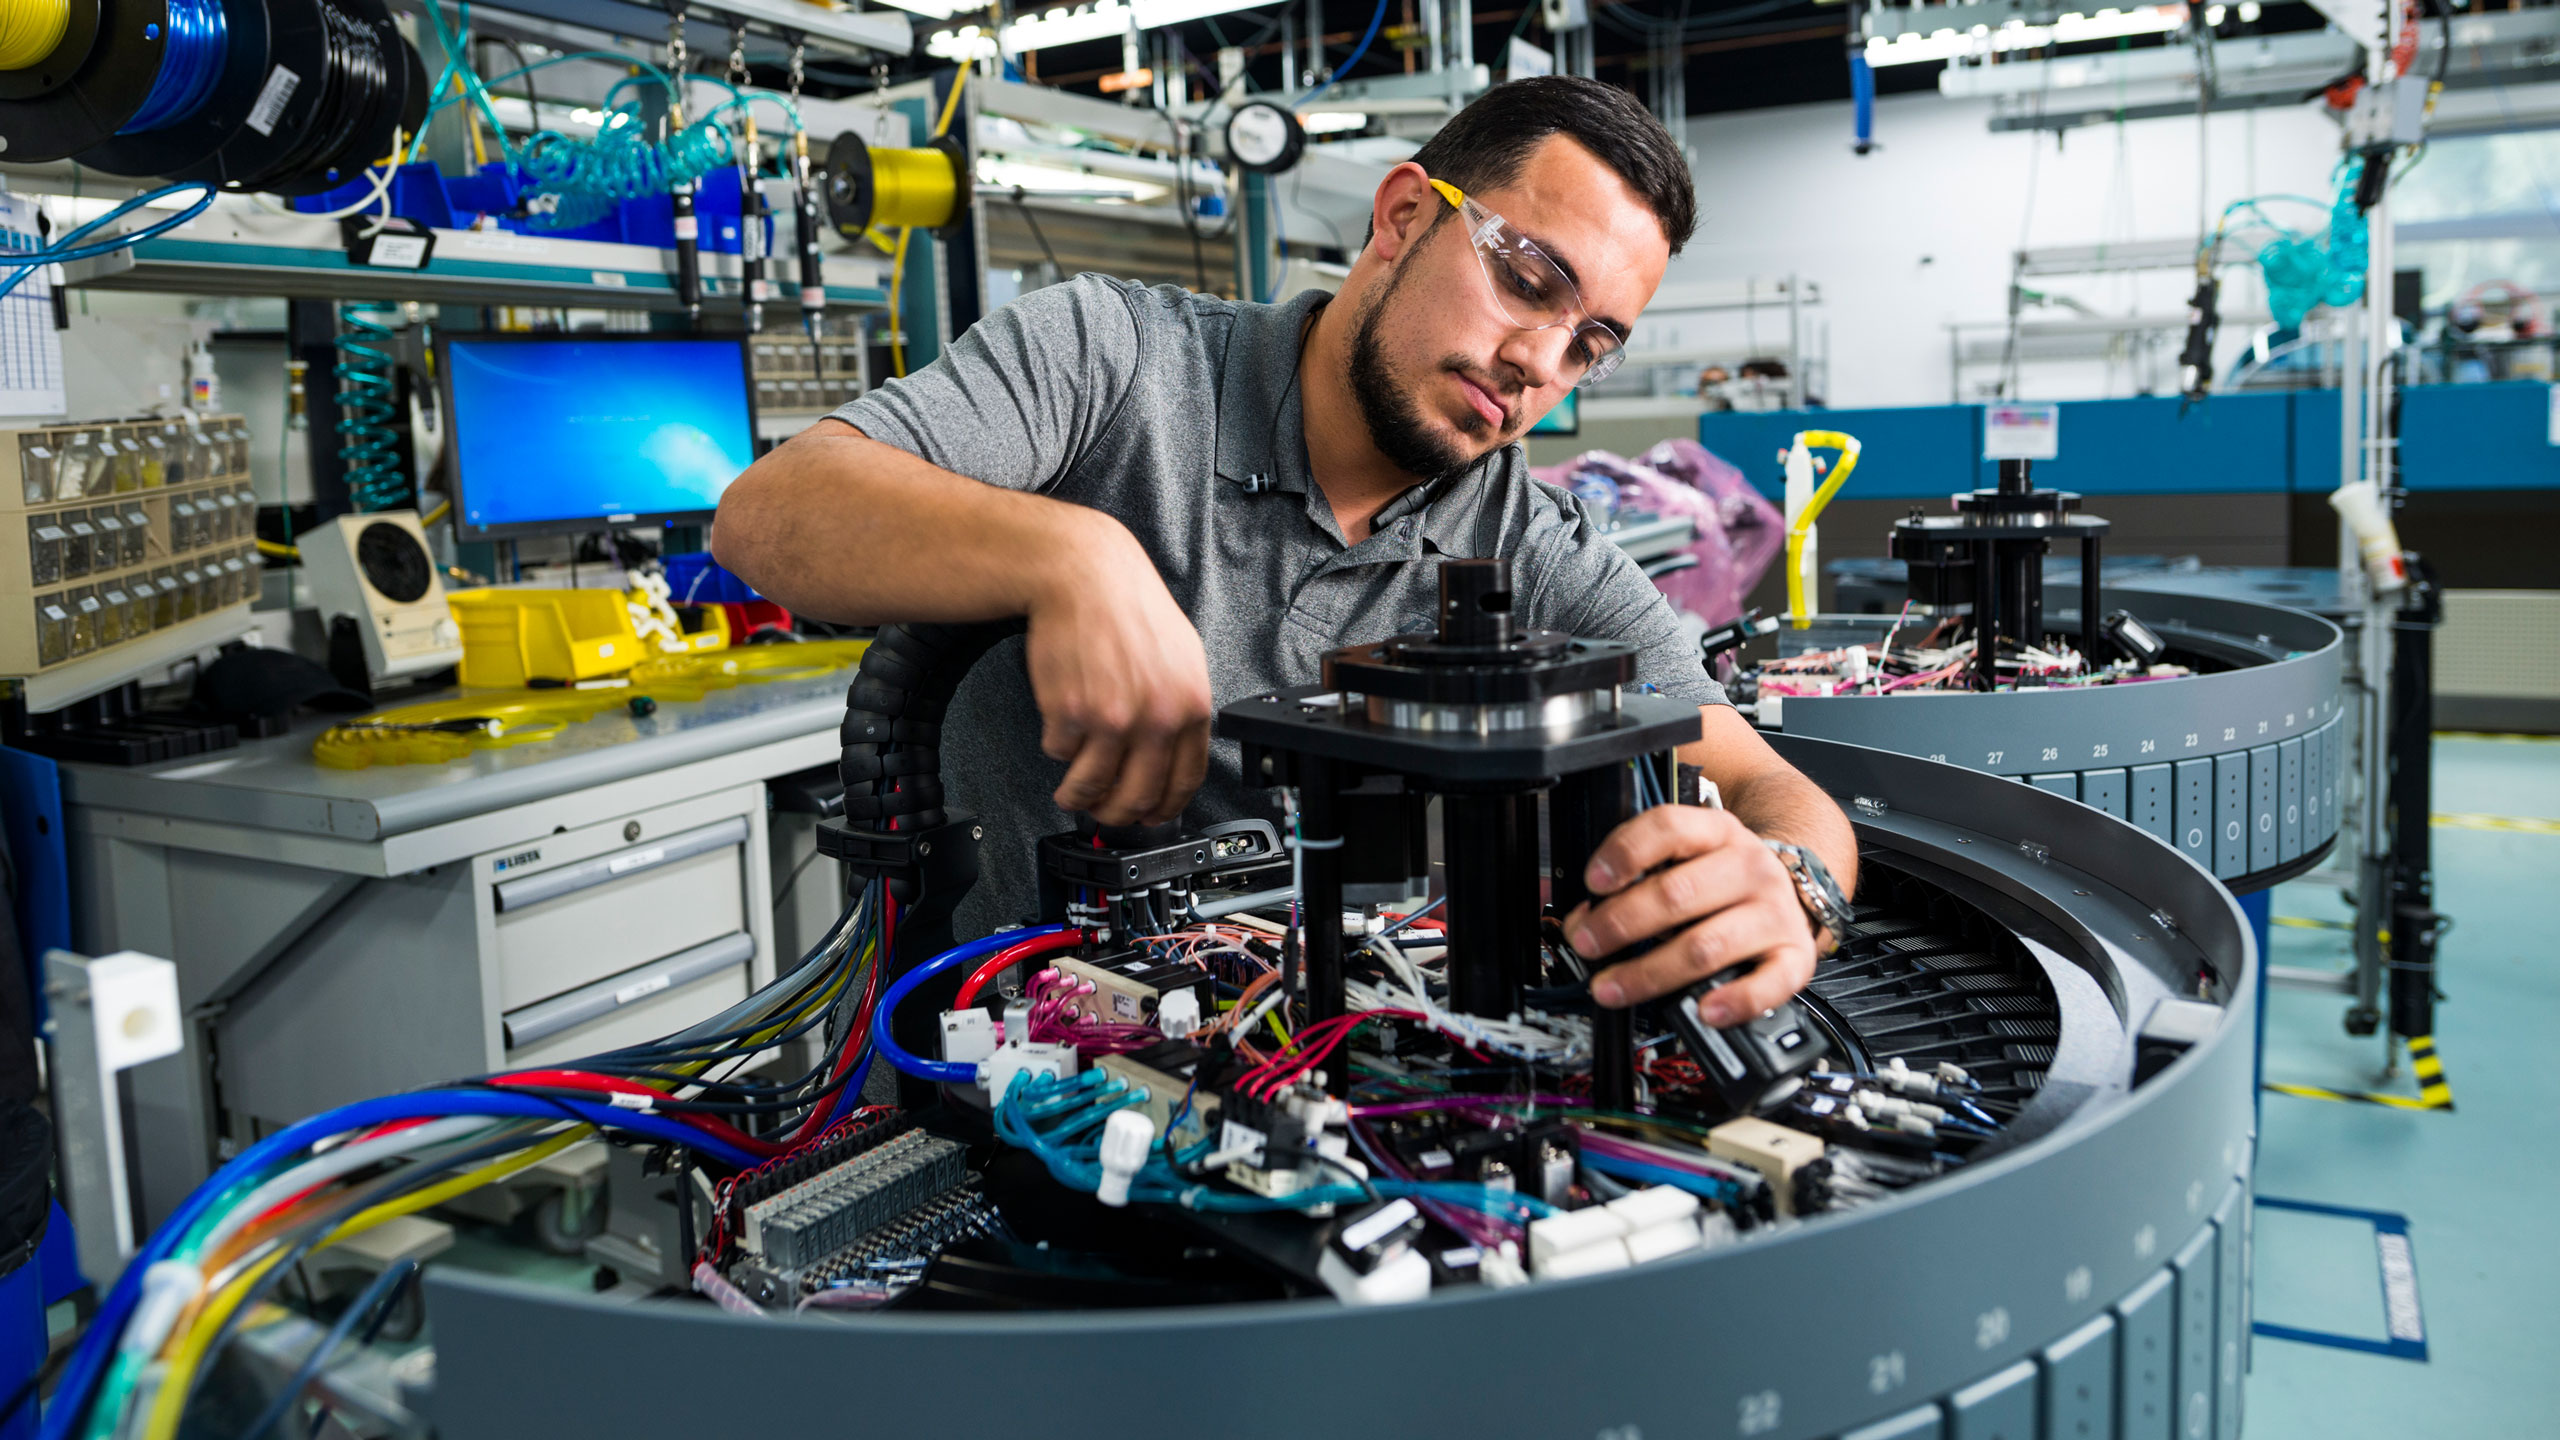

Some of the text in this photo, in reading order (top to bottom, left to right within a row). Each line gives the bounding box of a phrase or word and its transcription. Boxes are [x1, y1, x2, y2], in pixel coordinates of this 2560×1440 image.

[1987, 751, 2003, 765] 27
[2042, 747, 2058, 761] 26
[2093, 744, 2108, 758] 25
[2141, 739, 2155, 753] 24
[2185, 733, 2198, 747] 23
[2224, 727, 2236, 741] 22
[2258, 720, 2268, 735] 21
